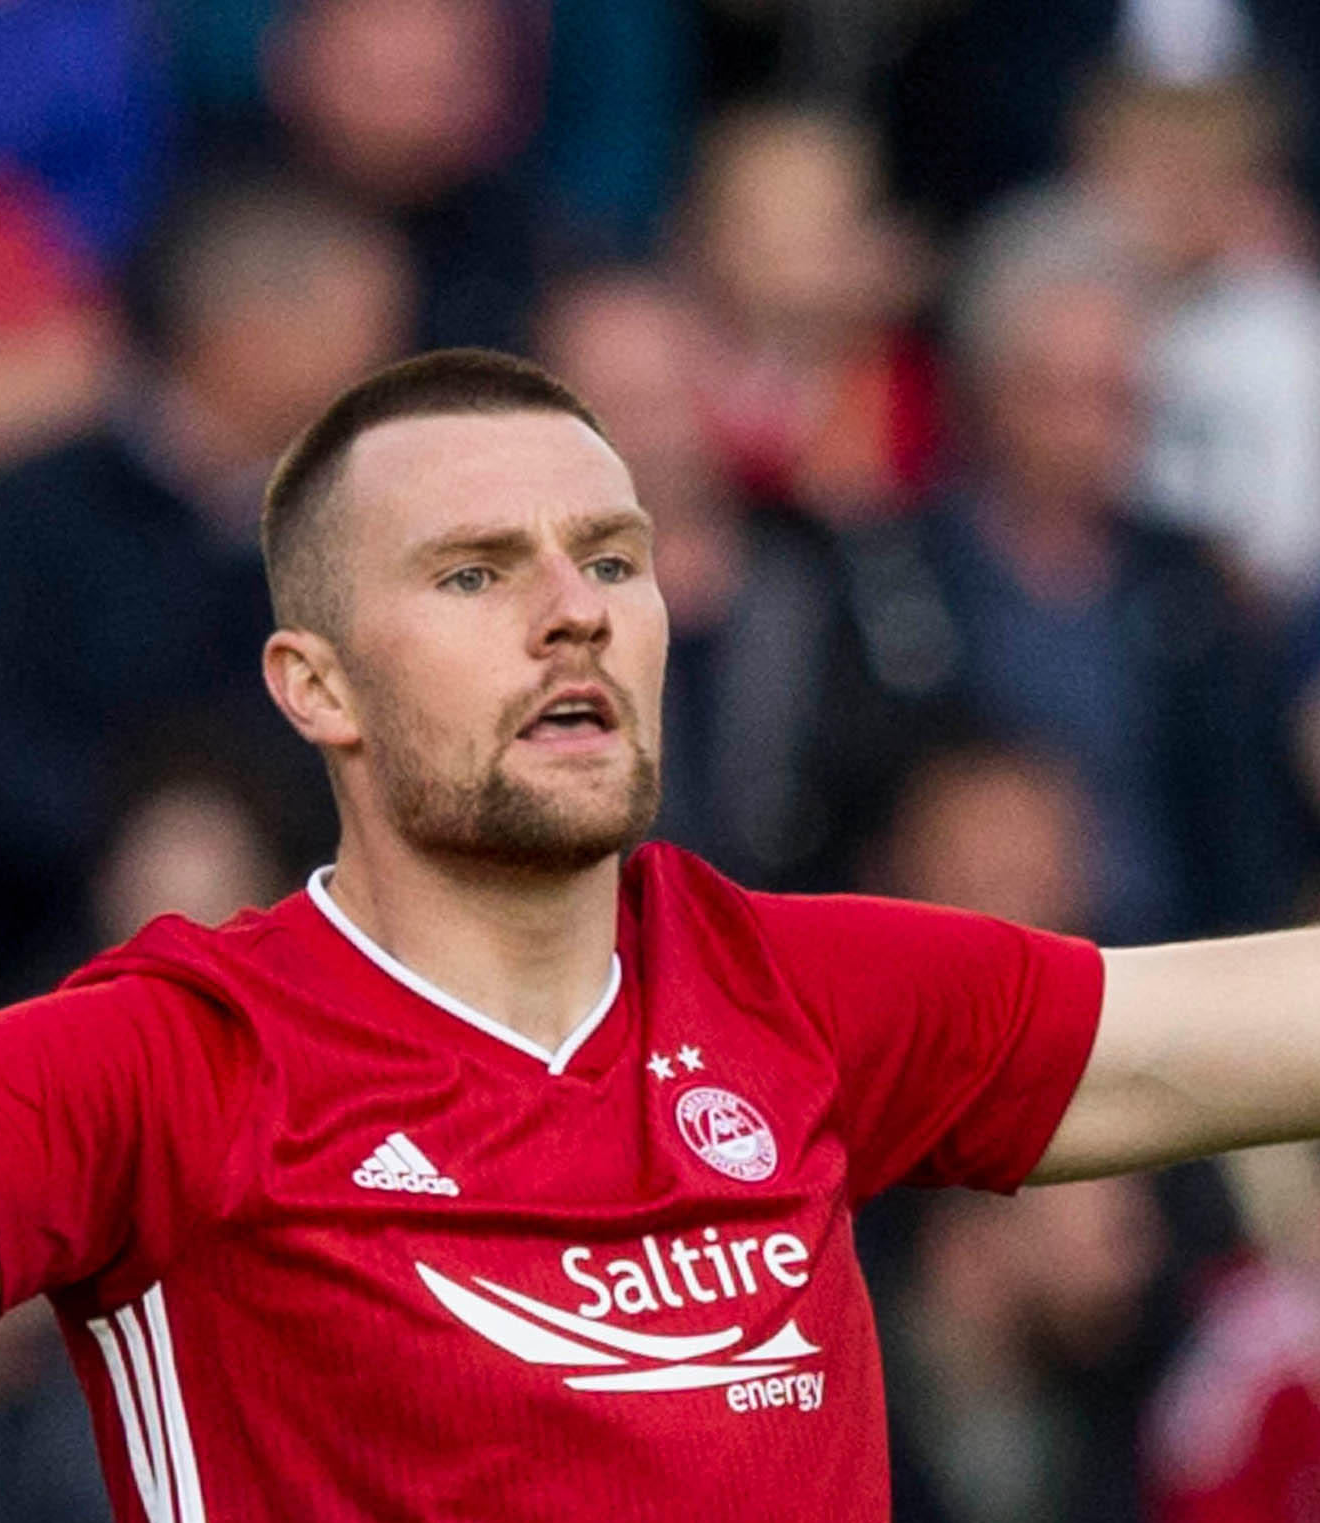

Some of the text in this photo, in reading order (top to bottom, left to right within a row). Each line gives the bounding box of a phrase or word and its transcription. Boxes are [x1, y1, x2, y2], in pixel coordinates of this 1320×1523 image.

[353, 1167, 460, 1197] adidas
[561, 1226, 810, 1319] Saltire
[727, 1371, 824, 1412] energy
